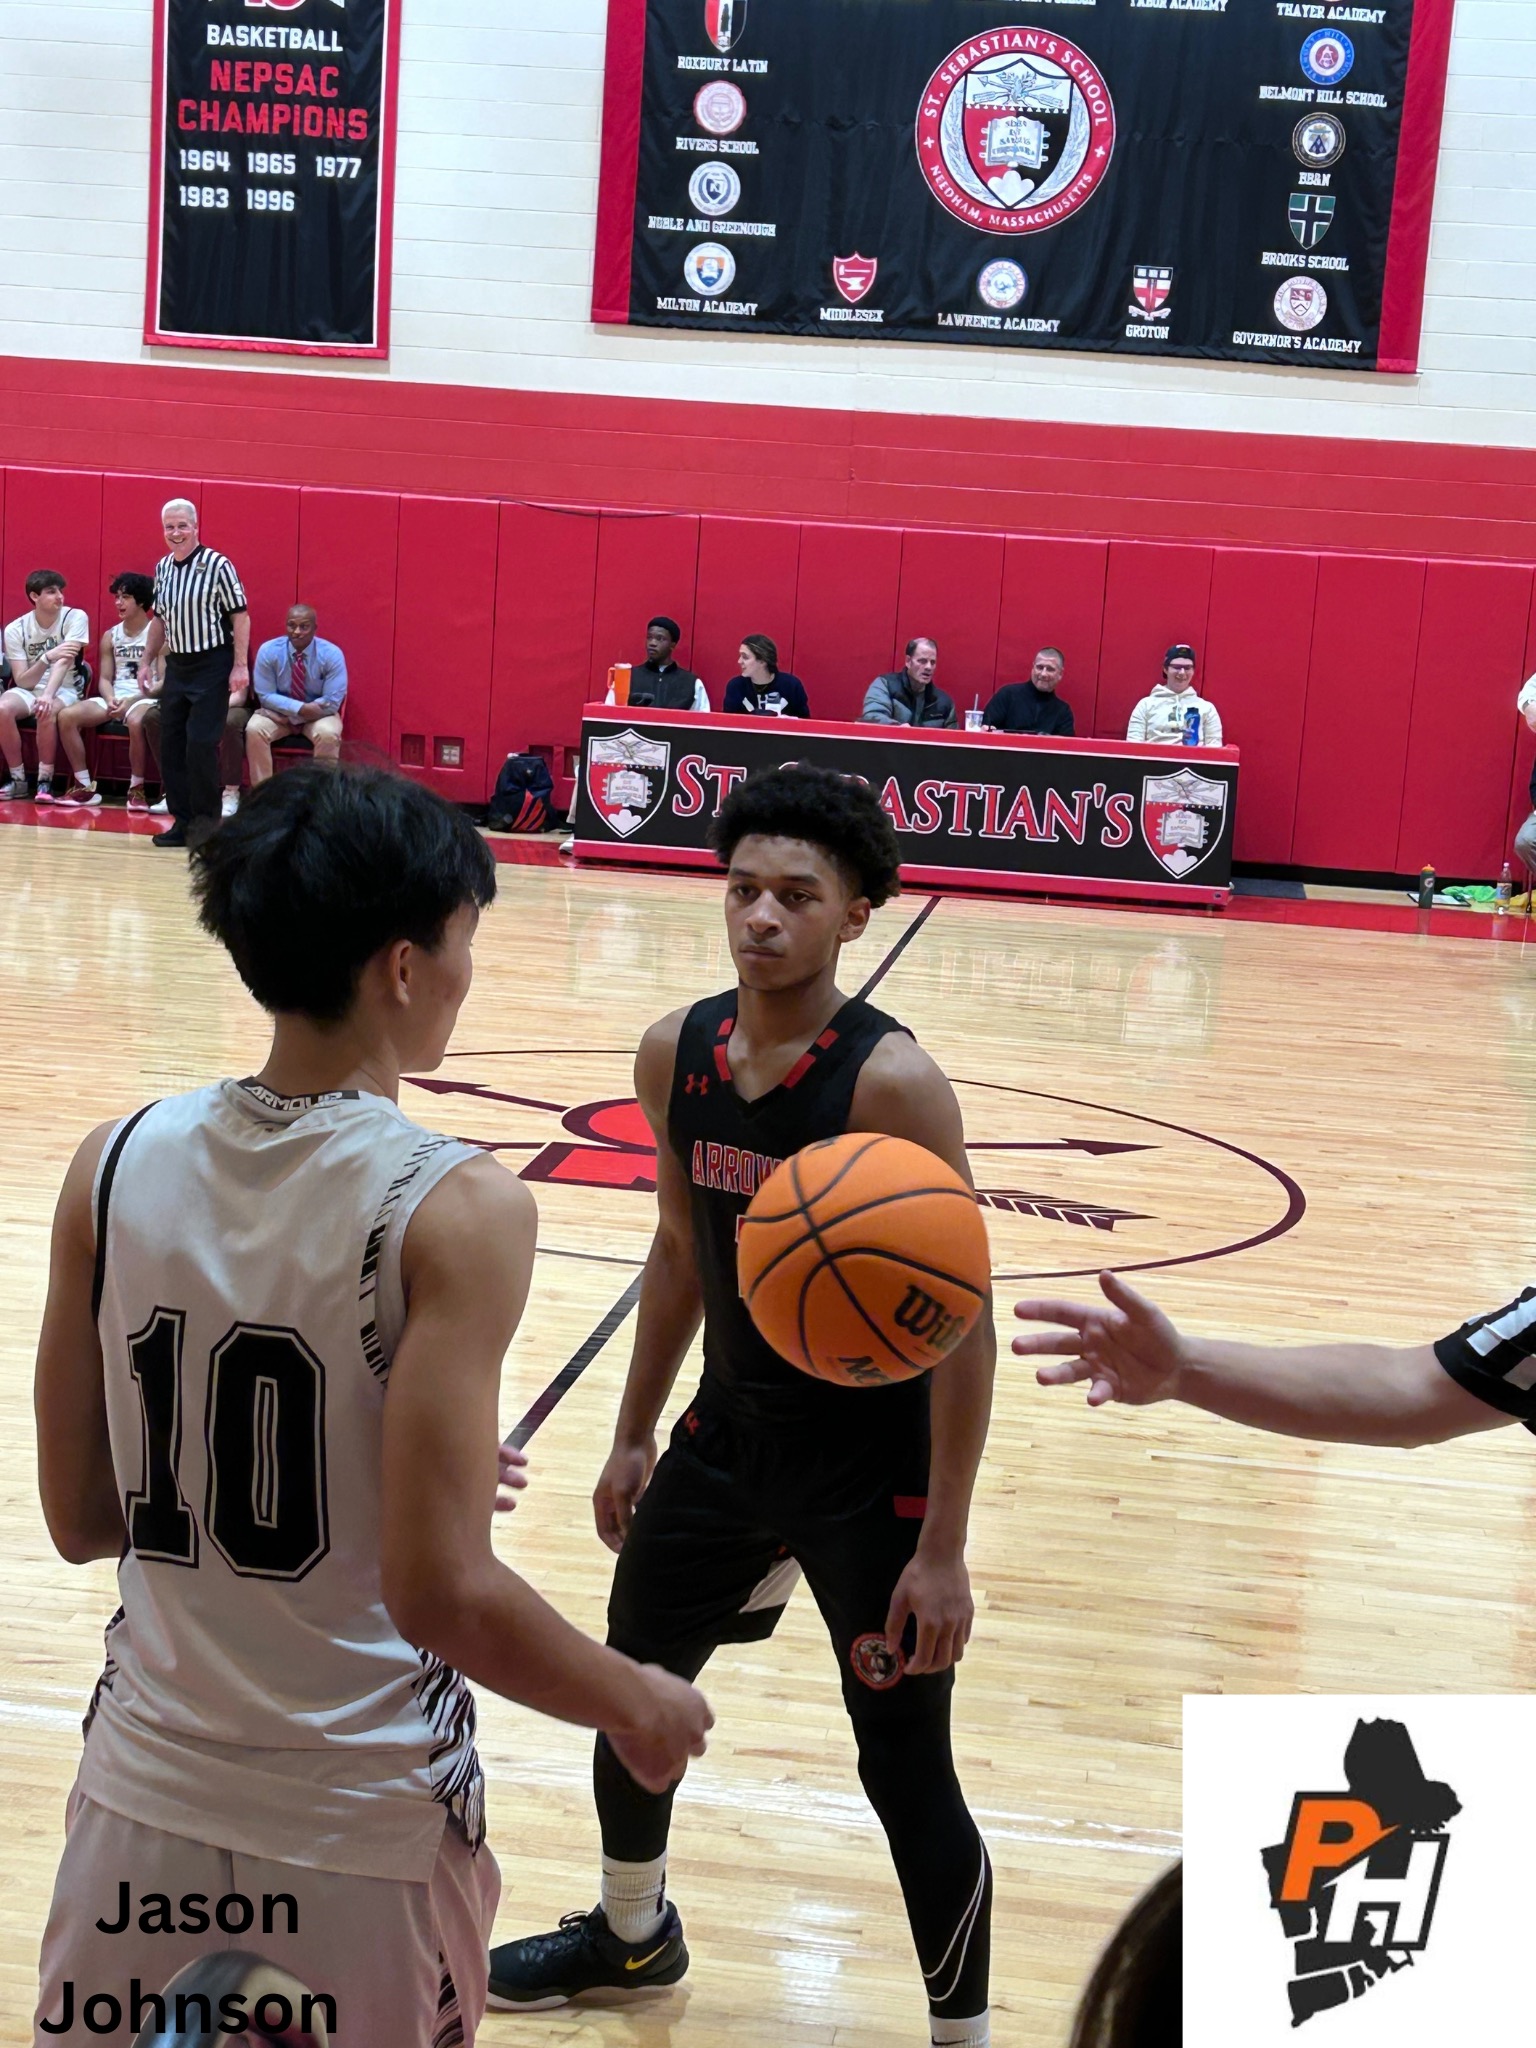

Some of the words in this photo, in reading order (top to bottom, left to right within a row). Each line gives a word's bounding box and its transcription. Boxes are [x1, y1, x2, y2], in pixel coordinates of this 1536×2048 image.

[1276, 3, 1325, 19] THAYER
[1327, 6, 1386, 23] ACADEMY
[207, 24, 343, 52] BASKETBALL
[678, 56, 731, 71] ROXBURY
[733, 58, 768, 73] LATIN
[210, 59, 339, 97] NEPSAC
[924, 92, 944, 118] ST.
[940, 33, 1058, 85] SEBASTIAN'S
[1061, 50, 1108, 126] SCHOOL
[1259, 86, 1315, 102] BELMONT
[1316, 89, 1343, 104] HILL
[1345, 91, 1387, 107] SCHOOL
[178, 99, 368, 139] CHAMPIONS
[676, 137, 718, 152] RIVERS
[719, 139, 759, 154] SCHOOL
[180, 149, 231, 172] 1964
[248, 152, 296, 174] 1965
[316, 156, 361, 178] 1977
[1298, 172, 1331, 187] BB&N
[180, 186, 229, 208] 1983
[247, 189, 295, 211] 1996
[930, 165, 983, 223] NEEDHAM,
[989, 173, 1092, 227] MASSACHUSETTS
[648, 216, 684, 231] NOBLE
[686, 219, 710, 232] AND
[712, 221, 776, 236] GREENOUGH
[1261, 252, 1306, 267] BROOKS
[1308, 255, 1349, 270] SCHOOL
[657, 297, 701, 311] MILTON
[703, 300, 758, 315] ACADEMY
[820, 308, 884, 322] MIDDLESEX
[938, 313, 1002, 329] LAWRENCE
[1003, 318, 1060, 332] ACADEMY
[1125, 324, 1169, 339] GROTON
[1233, 331, 1302, 349] GOVERNOR'S
[1303, 337, 1361, 353] ACADEMY
[126, 1305, 331, 1582] 10
